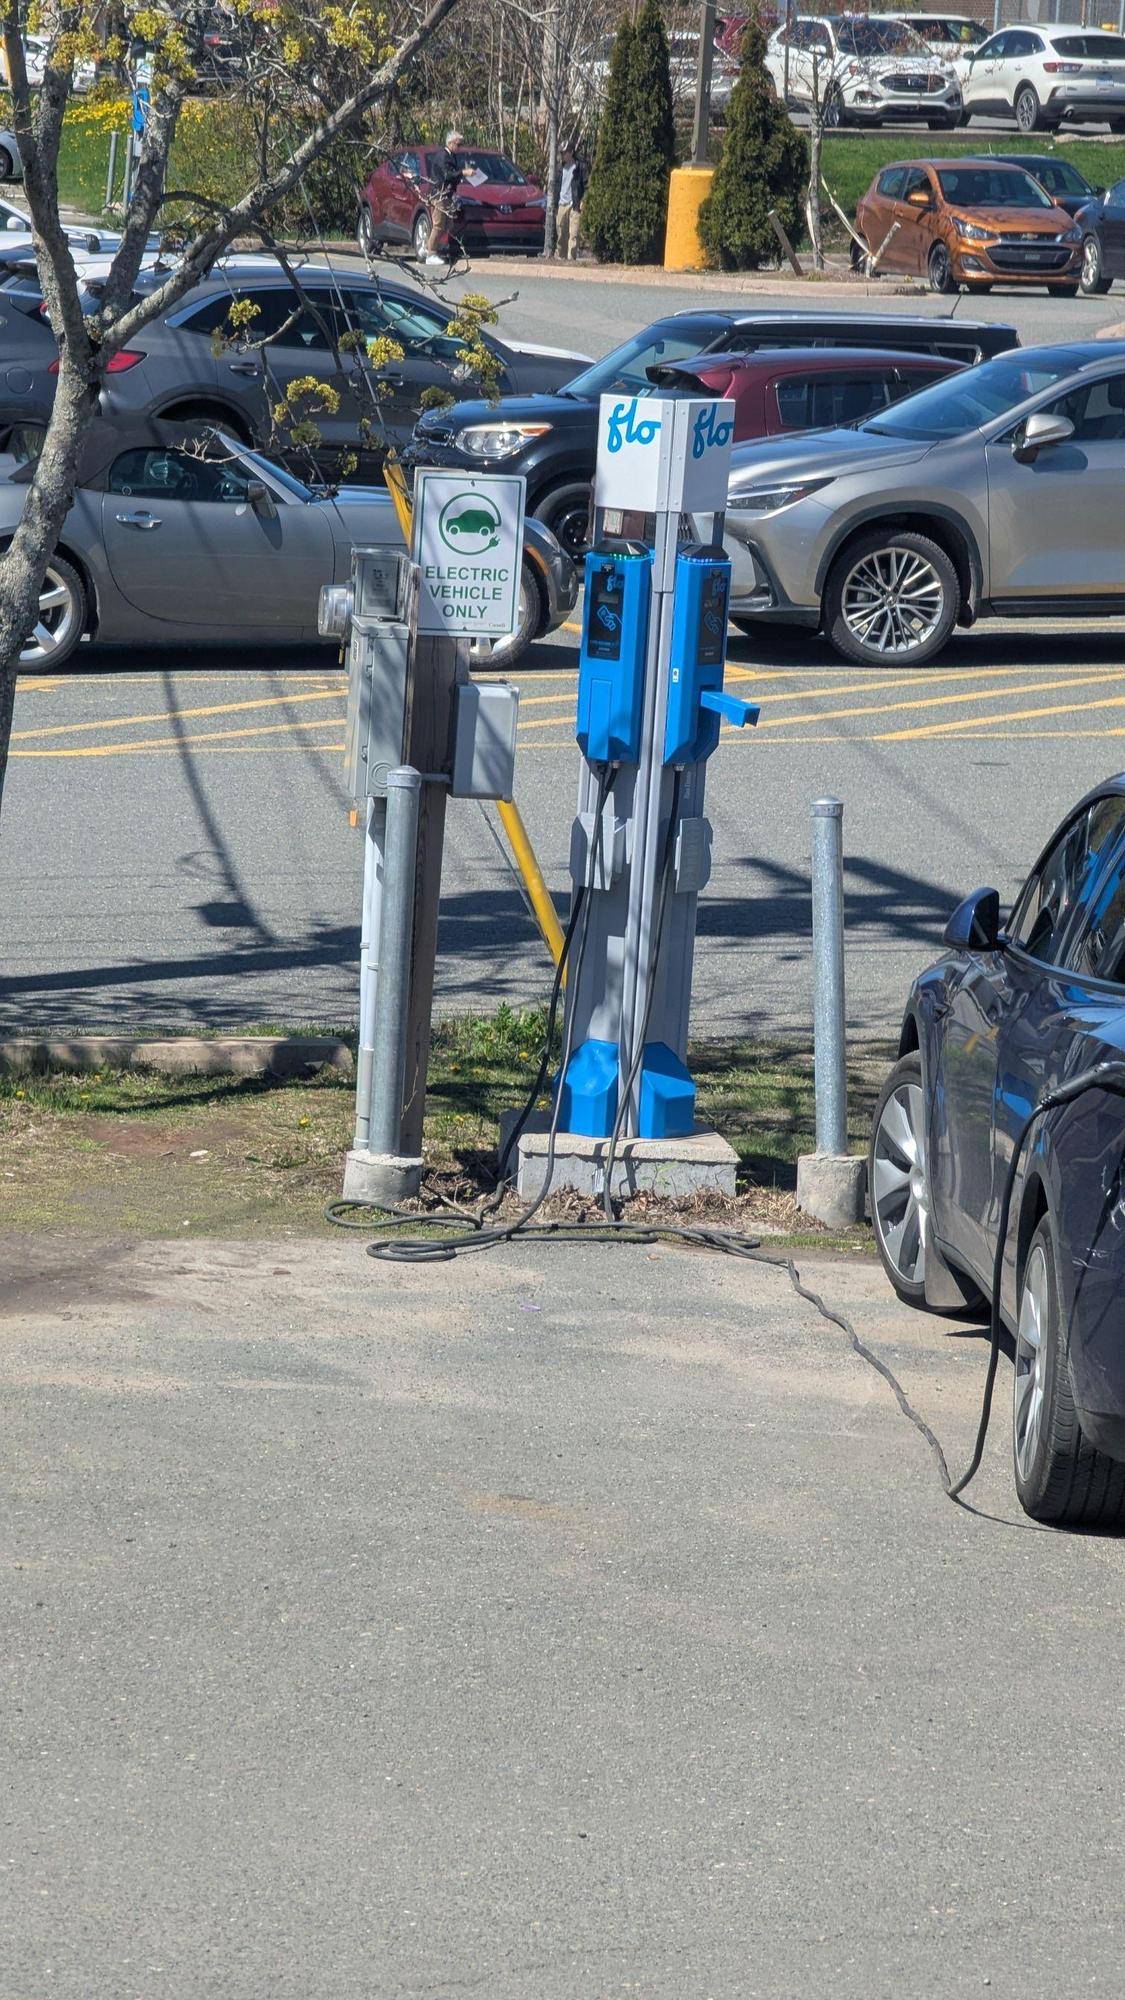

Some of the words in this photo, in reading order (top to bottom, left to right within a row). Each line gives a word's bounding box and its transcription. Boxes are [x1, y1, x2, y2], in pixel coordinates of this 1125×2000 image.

[608, 399, 661, 453] flo
[693, 402, 735, 459] flo
[425, 566, 509, 582] ELECTRIC
[430, 585, 503, 601] VEHICLE
[442, 604, 488, 619] ONLY
